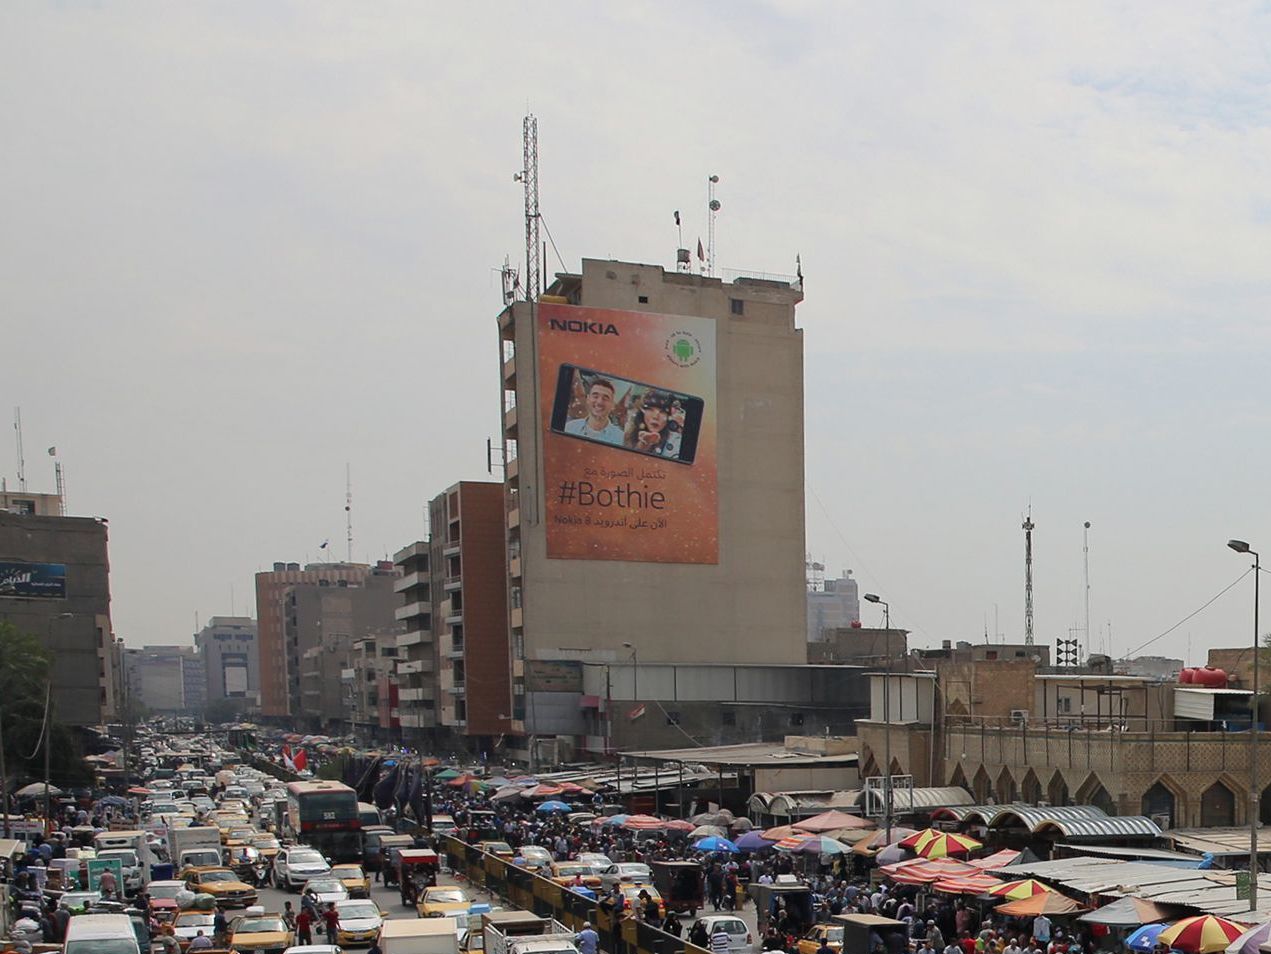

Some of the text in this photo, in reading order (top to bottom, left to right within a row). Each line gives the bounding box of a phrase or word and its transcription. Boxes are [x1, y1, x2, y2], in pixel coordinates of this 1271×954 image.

[550, 318, 620, 337] NOKIA
[558, 480, 666, 510] #Bothie
[554, 515, 583, 526] Nokia
